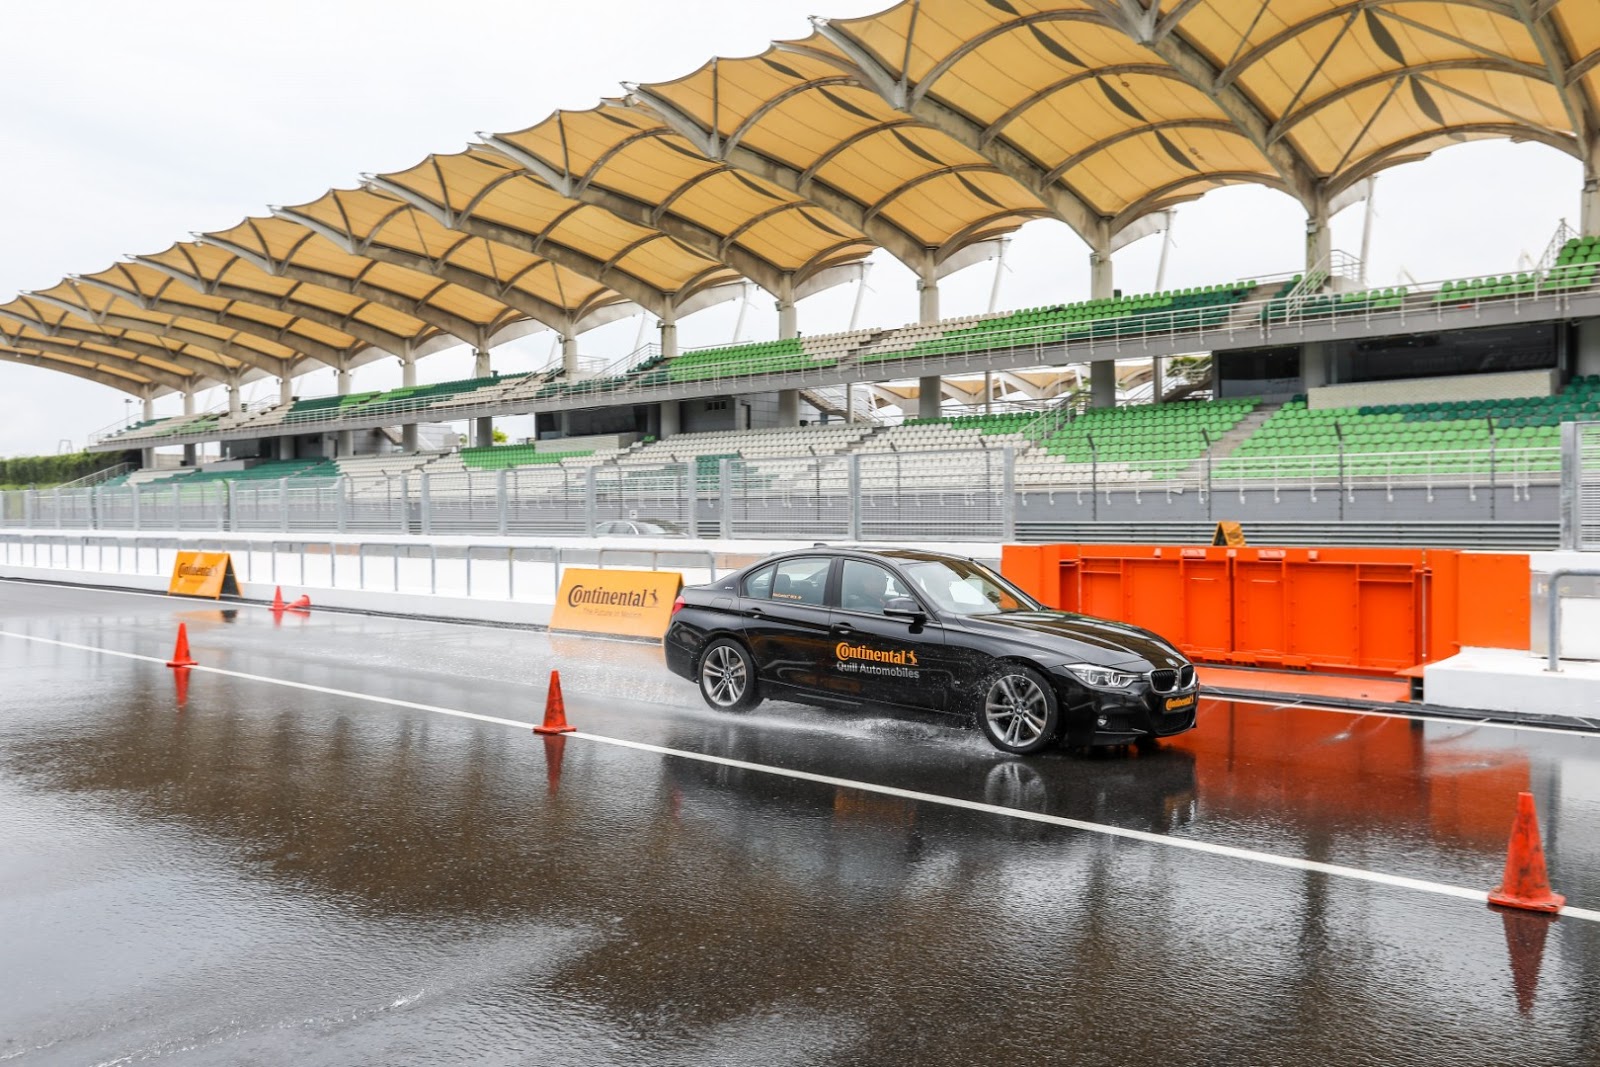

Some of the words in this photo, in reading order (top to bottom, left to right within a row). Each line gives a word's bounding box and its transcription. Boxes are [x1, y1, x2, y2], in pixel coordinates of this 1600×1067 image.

[568, 584, 647, 608] Continental
[835, 641, 906, 665] Continental
[836, 661, 857, 672] Quill
[859, 663, 920, 679] Automobiles
[1165, 695, 1190, 711] Continental
